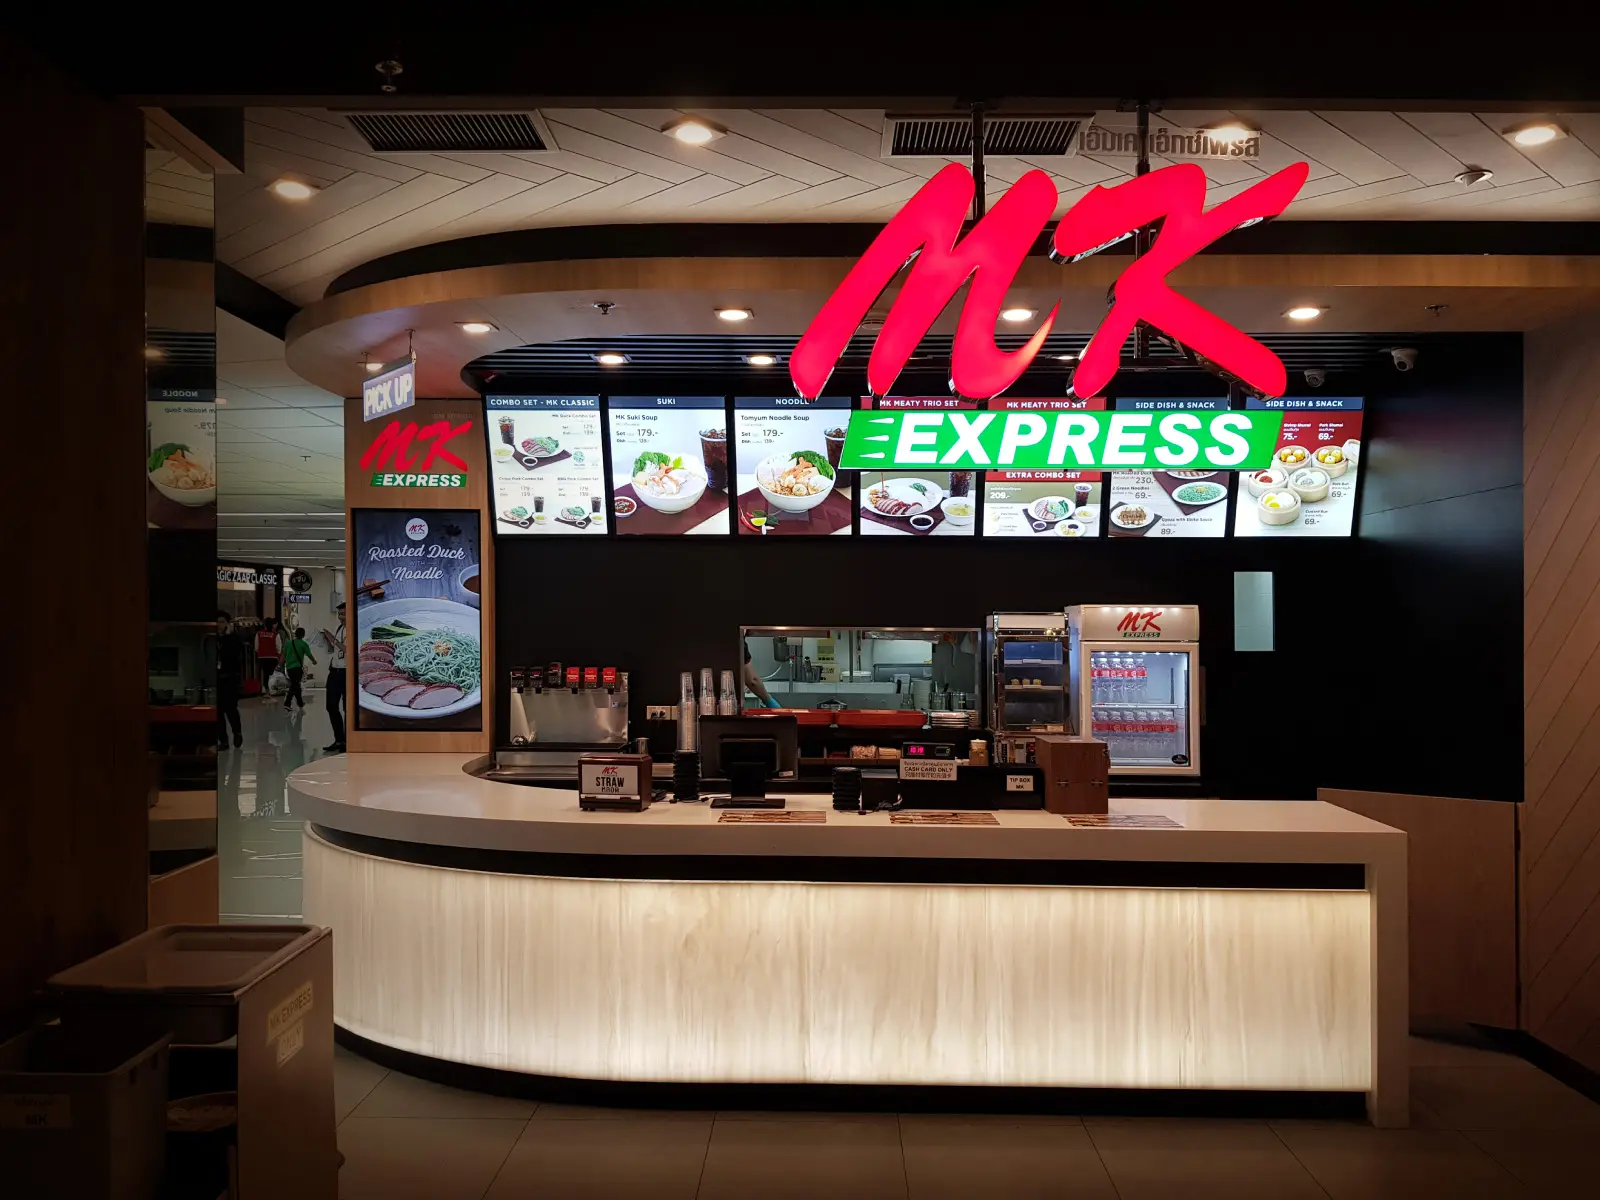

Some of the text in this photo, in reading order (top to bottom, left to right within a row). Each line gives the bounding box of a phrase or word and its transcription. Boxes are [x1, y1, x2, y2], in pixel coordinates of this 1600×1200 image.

[788, 161, 1310, 400] MK
[365, 373, 413, 417] PICK UP
[1071, 401, 1087, 409] SET
[637, 428, 658, 437] 179.-
[763, 429, 783, 437] 179.-
[1283, 432, 1298, 440] 75.-
[1318, 432, 1334, 440] 69.-
[893, 412, 1253, 466] EXPRESS
[359, 419, 473, 472] MK
[382, 474, 461, 487] EXPRESS
[408, 524, 426, 532] MK
[368, 544, 466, 562] Roasted Duck
[251, 573, 278, 585] CLASSIC
[392, 566, 444, 581] Noodle
[1116, 612, 1162, 632] MK
[601, 766, 619, 774] MK
[596, 777, 624, 788] STRAW
[25, 1113, 48, 1126] MK
